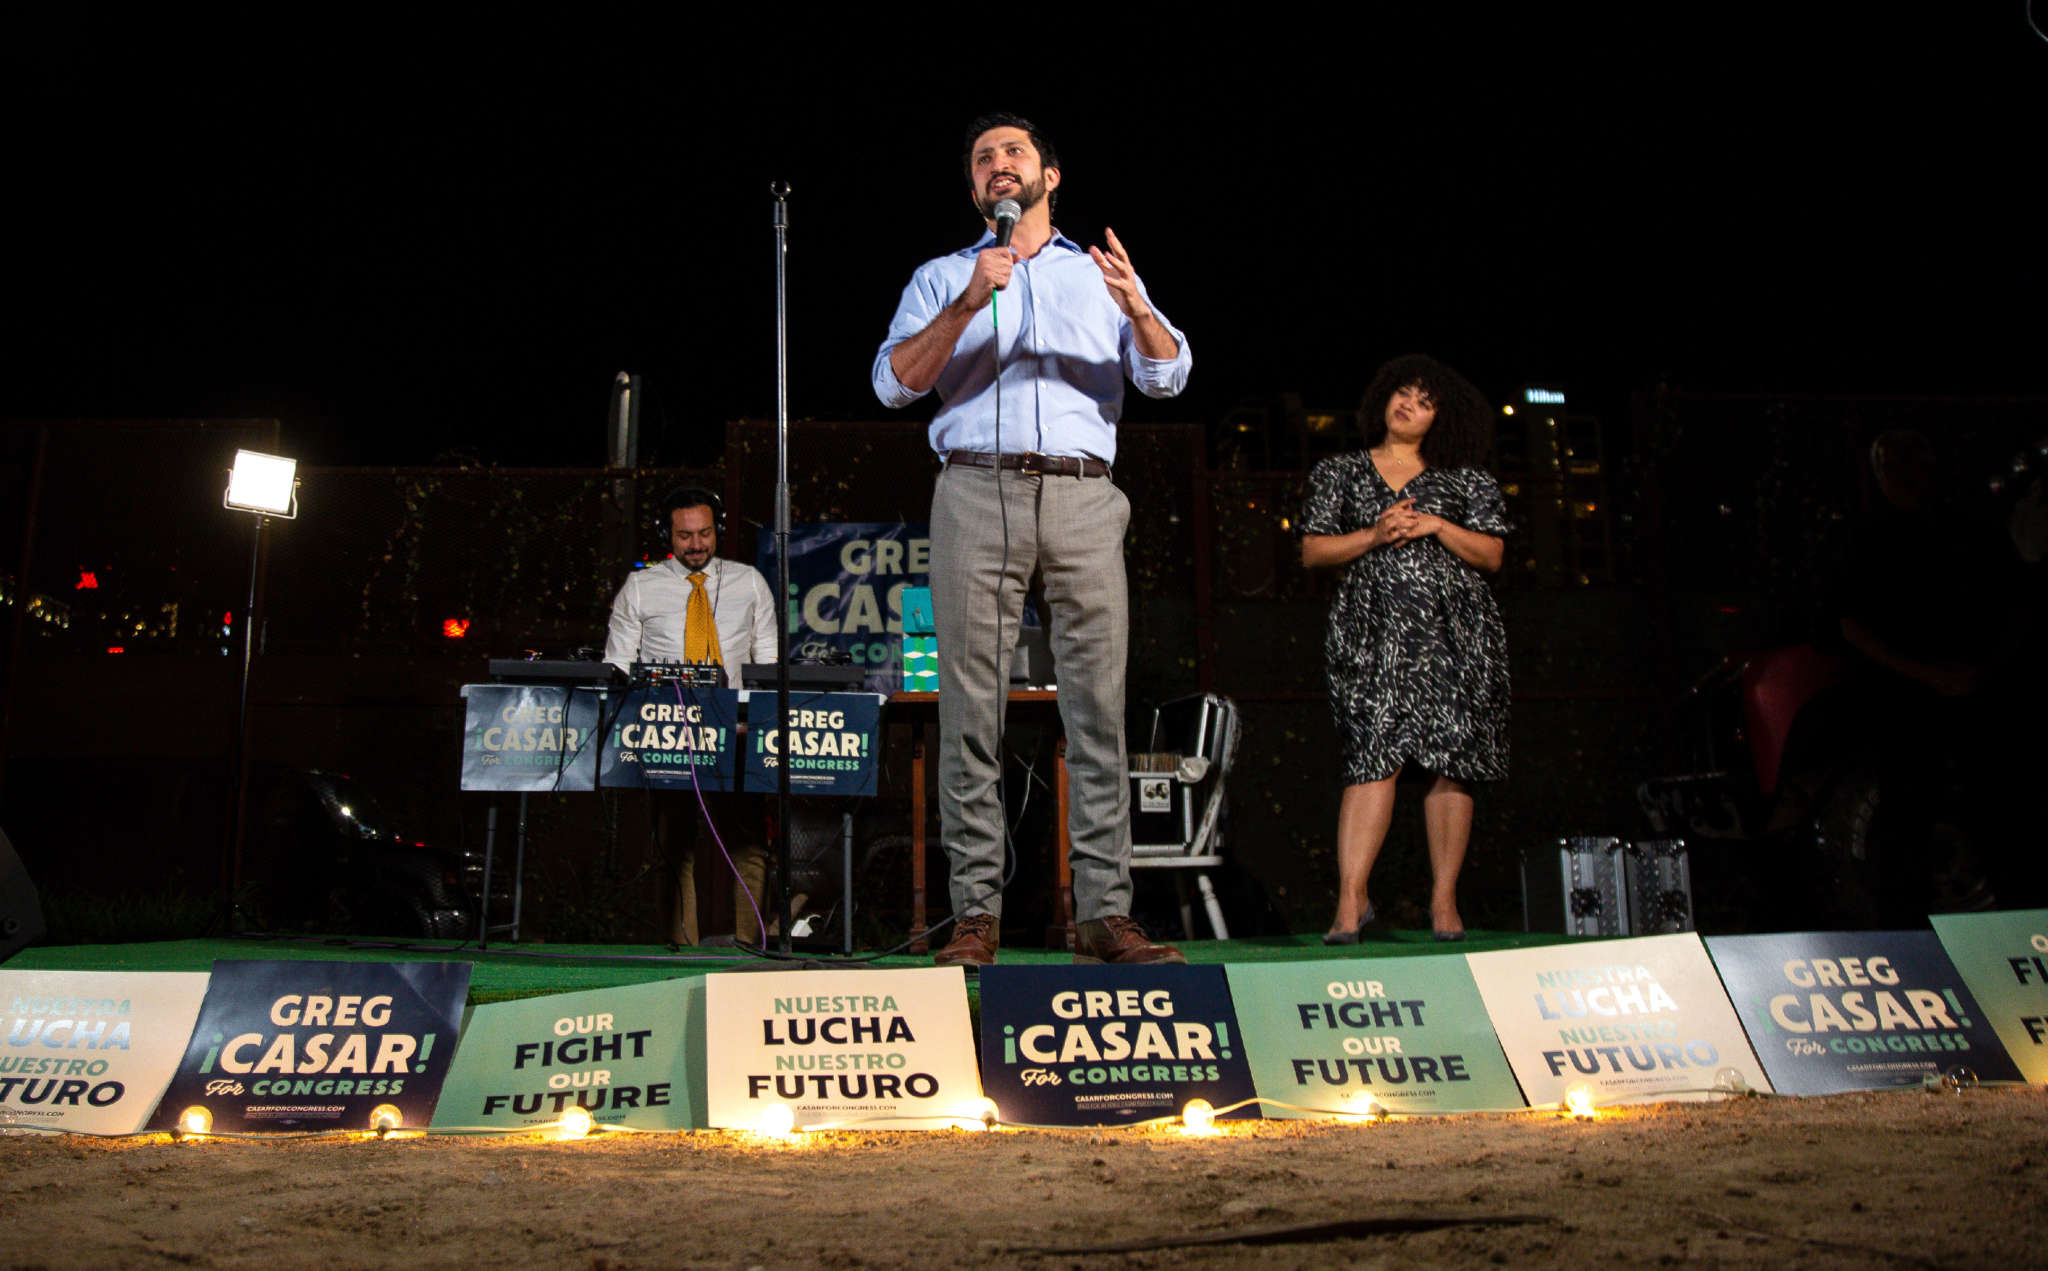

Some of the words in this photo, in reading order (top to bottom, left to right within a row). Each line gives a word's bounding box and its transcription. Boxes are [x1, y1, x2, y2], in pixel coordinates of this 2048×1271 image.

[840, 538, 930, 575] GRE
[789, 582, 912, 635] ¡CAS
[502, 705, 562, 724] GREG
[641, 703, 702, 723] GREG
[788, 709, 845, 730] GREG
[614, 723, 727, 753] ¡CASAR!
[757, 729, 869, 758] ¡CASAR!
[763, 756, 779, 769] Fo
[1536, 964, 1652, 990] NUESTRA
[1783, 956, 1901, 988] GREG
[1327, 980, 1386, 1000] OUR
[1534, 983, 1681, 1021] LUCHA
[8, 994, 132, 1017] NUESTRA
[270, 994, 393, 1027] GREG
[774, 995, 899, 1014] NUESTRA
[1052, 990, 1174, 1020] GREG
[1297, 1000, 1426, 1030] FIGHT
[1752, 987, 1973, 1034] ¡CASAR!
[553, 1012, 614, 1037] OUR
[763, 1016, 915, 1046] LUCHA
[1559, 1019, 1679, 1045] NUESTRO
[199, 1033, 436, 1074] ¡CASAR!
[514, 1030, 652, 1070] FIGHT
[1003, 1022, 1233, 1065] ¡CASAR!
[1342, 1036, 1404, 1055] OUR
[1786, 1038, 1827, 1057] For
[1829, 1033, 1972, 1055] CONGRESS
[0, 1056, 110, 1077] UESTRO
[775, 1053, 906, 1071] NUESTRO
[1291, 1054, 1471, 1086] FUTURE
[1542, 1039, 1720, 1077] FUTURO
[205, 1079, 246, 1097] For
[252, 1080, 405, 1096] CONGRESS
[548, 1069, 612, 1090] OUR
[748, 1073, 940, 1100] FUTURO
[1020, 1068, 1062, 1087] For
[1068, 1065, 1221, 1085] CONGRESS
[482, 1082, 671, 1116] FUTURE
